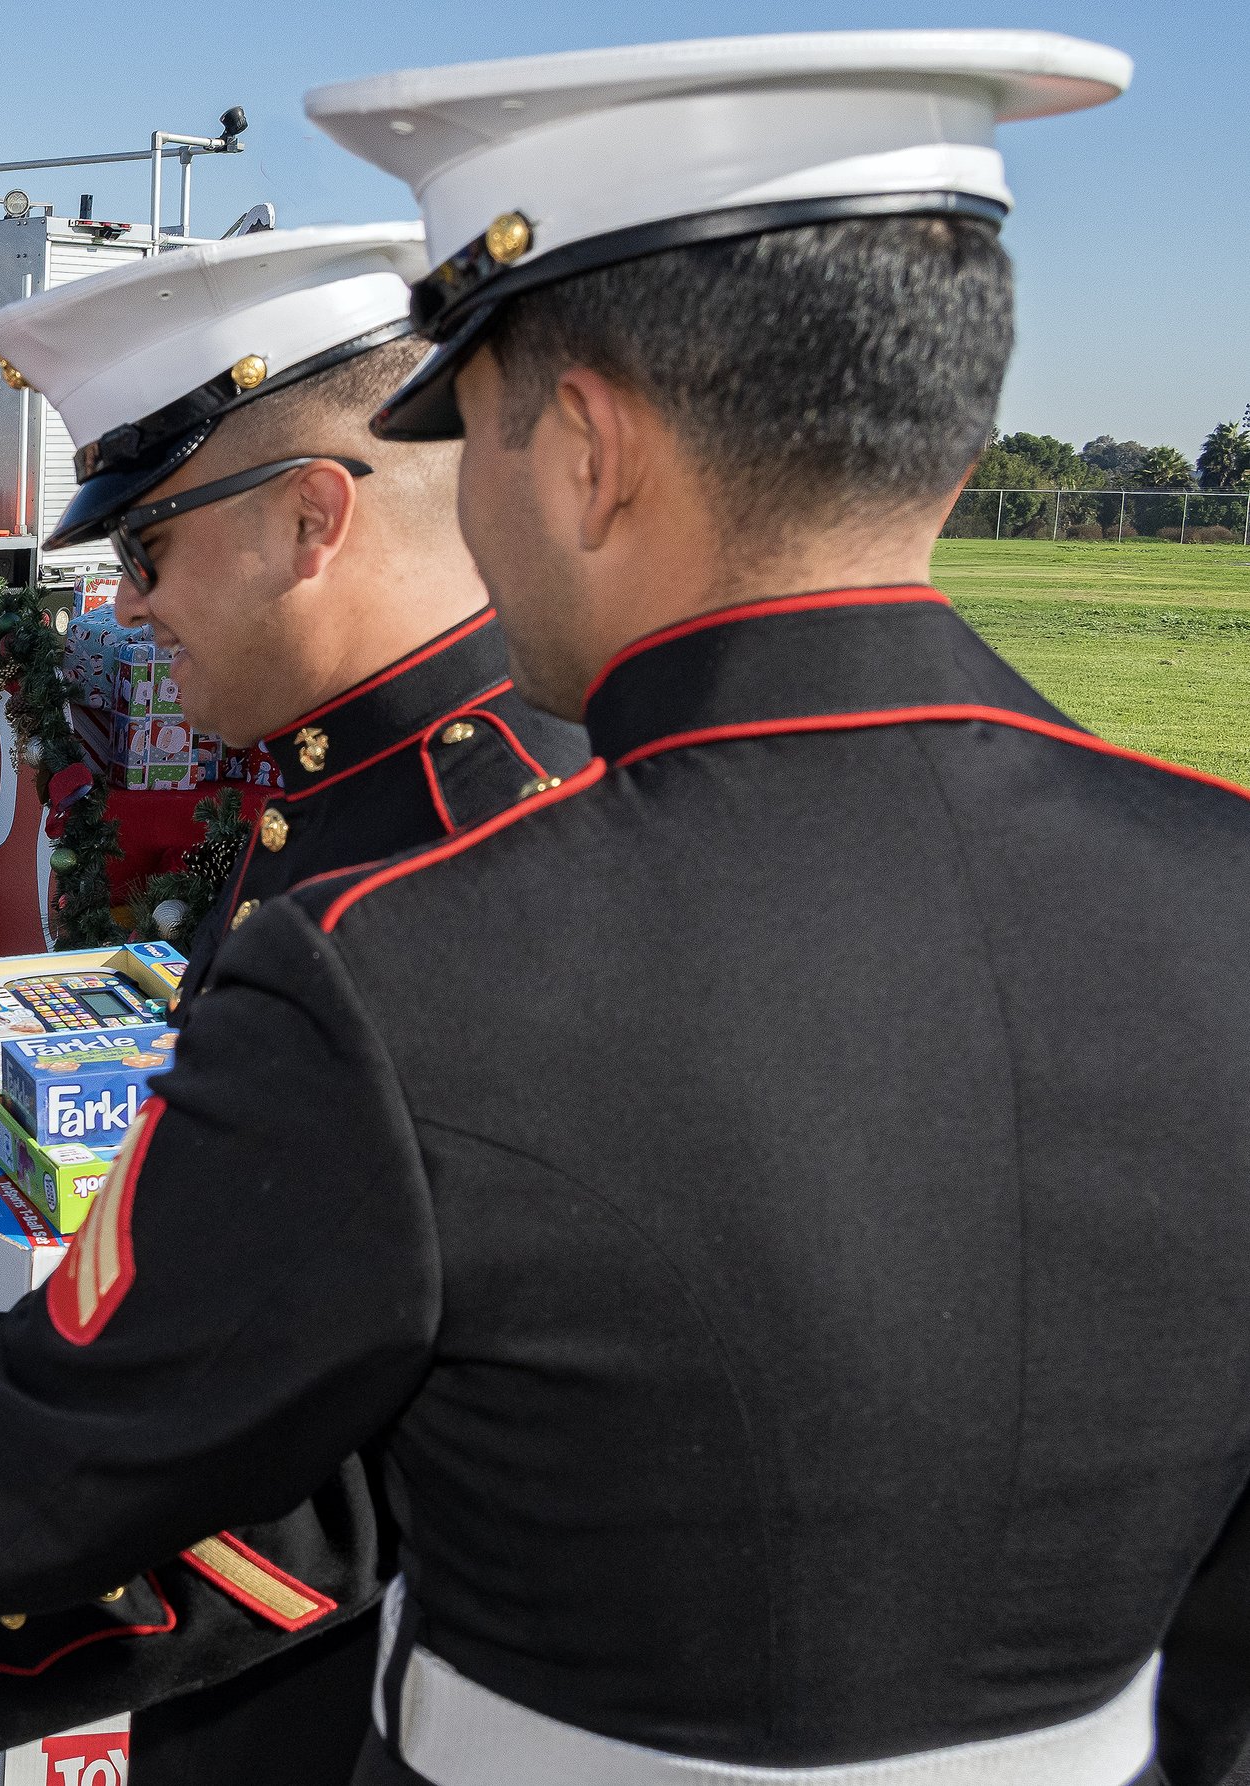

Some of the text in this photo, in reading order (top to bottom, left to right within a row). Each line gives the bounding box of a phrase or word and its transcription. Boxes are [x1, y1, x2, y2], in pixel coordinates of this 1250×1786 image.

[16, 1035, 137, 1058] Farkle
[48, 1085, 142, 1138] Farkl
[32, 1227, 51, 1246] Set
